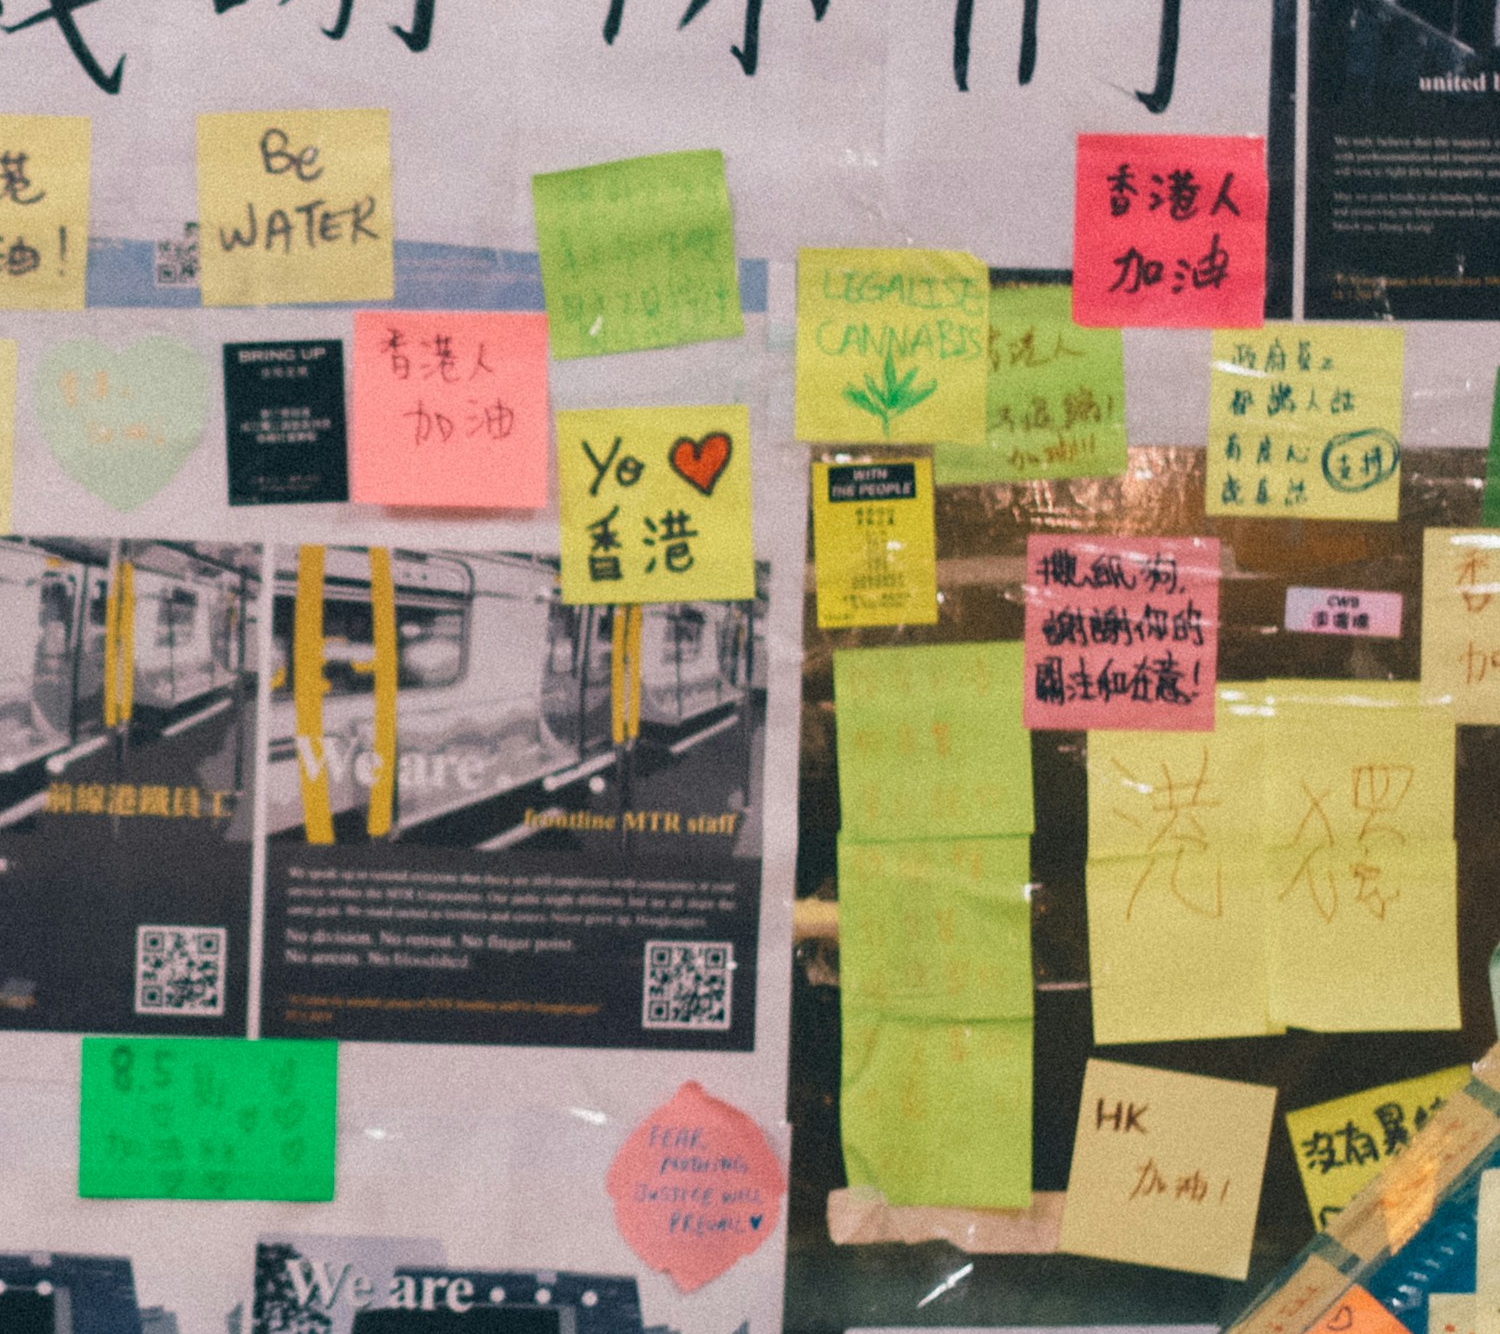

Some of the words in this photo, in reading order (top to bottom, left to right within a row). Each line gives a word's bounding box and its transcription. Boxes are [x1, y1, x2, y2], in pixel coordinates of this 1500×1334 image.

[258, 129, 324, 184] Be
[1105, 171, 1242, 221] 香港人
[218, 197, 382, 259] WATER
[1104, 242, 1234, 296] 加油
[380, 331, 498, 384] 香港人
[816, 322, 983, 362] CANNABIS
[411, 401, 518, 447] 加油
[585, 510, 699, 584] 香港
[1094, 1100, 1150, 1135] HK
[287, 1258, 370, 1308] We
[389, 1275, 474, 1311] are
